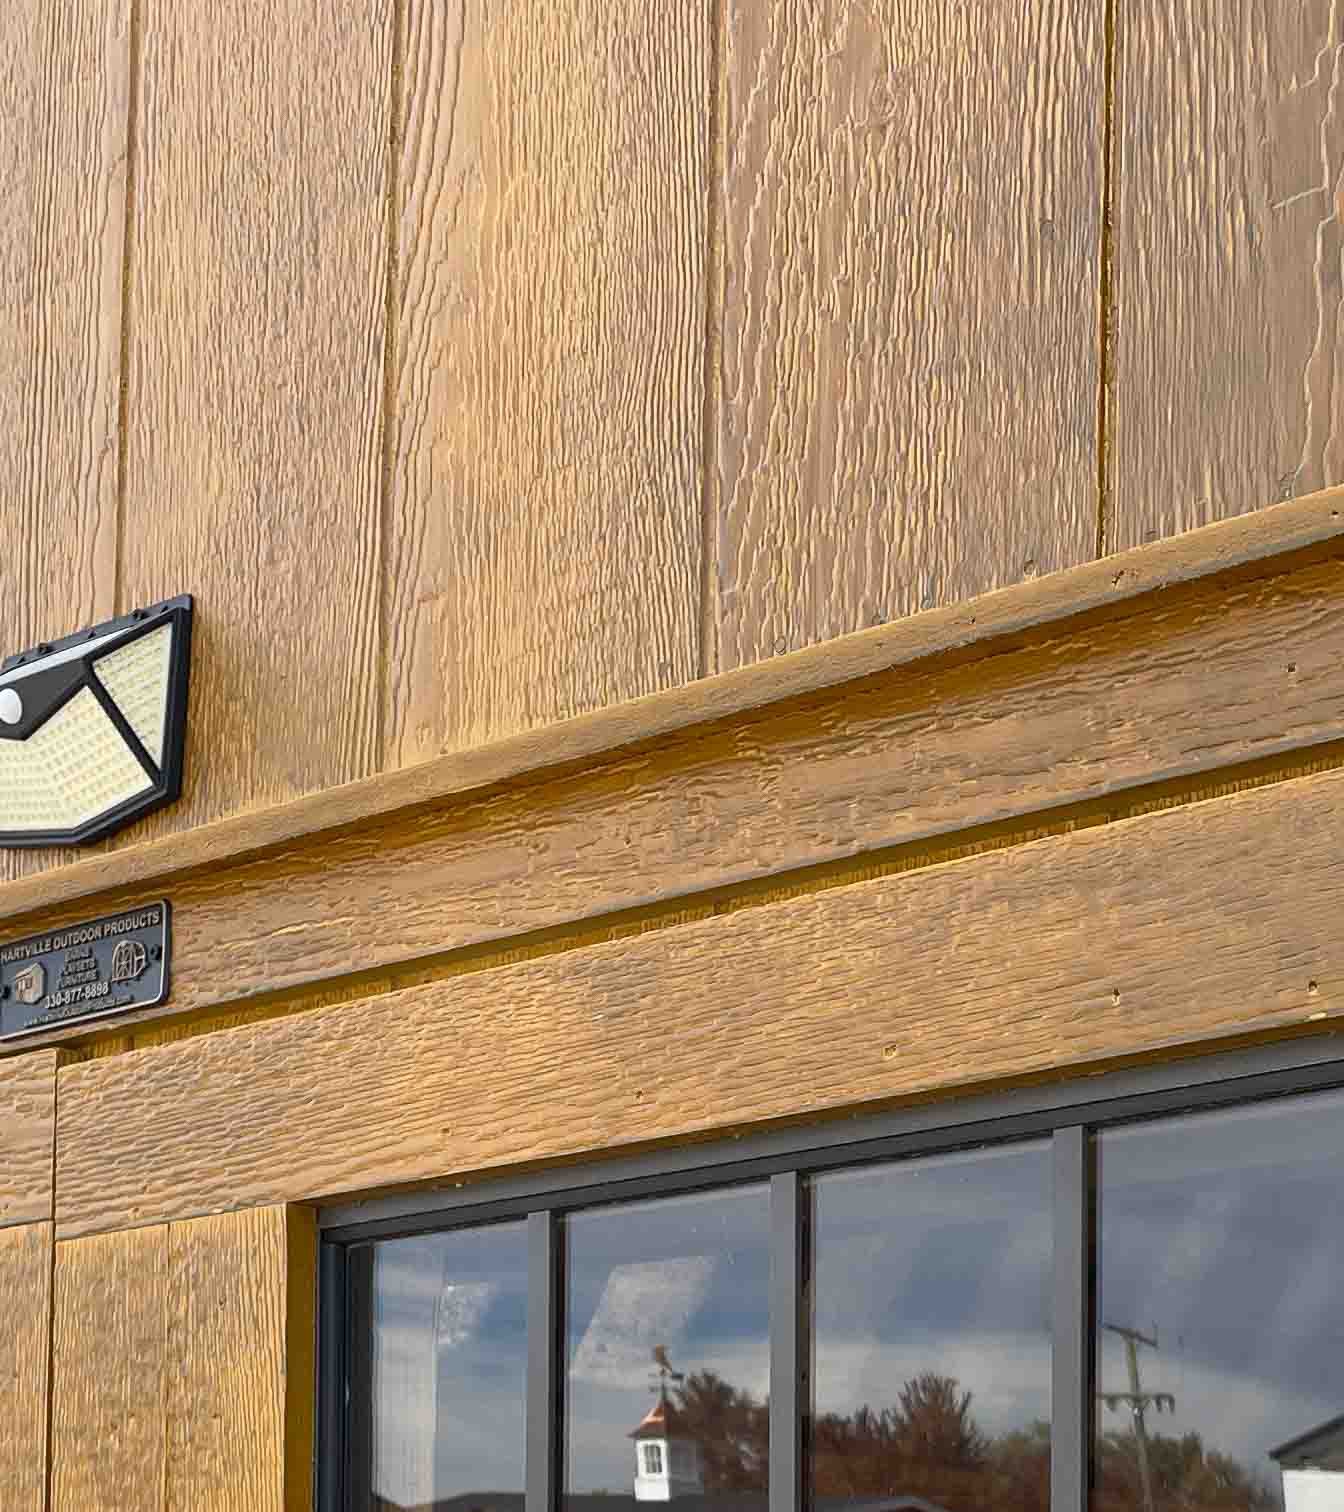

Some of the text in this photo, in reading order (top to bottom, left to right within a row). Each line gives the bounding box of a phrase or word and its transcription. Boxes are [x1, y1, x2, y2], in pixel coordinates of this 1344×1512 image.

[0, 938, 52, 962] HARTVILLE
[53, 926, 104, 949] OUTDOOR
[104, 910, 160, 936] PRODUCTS
